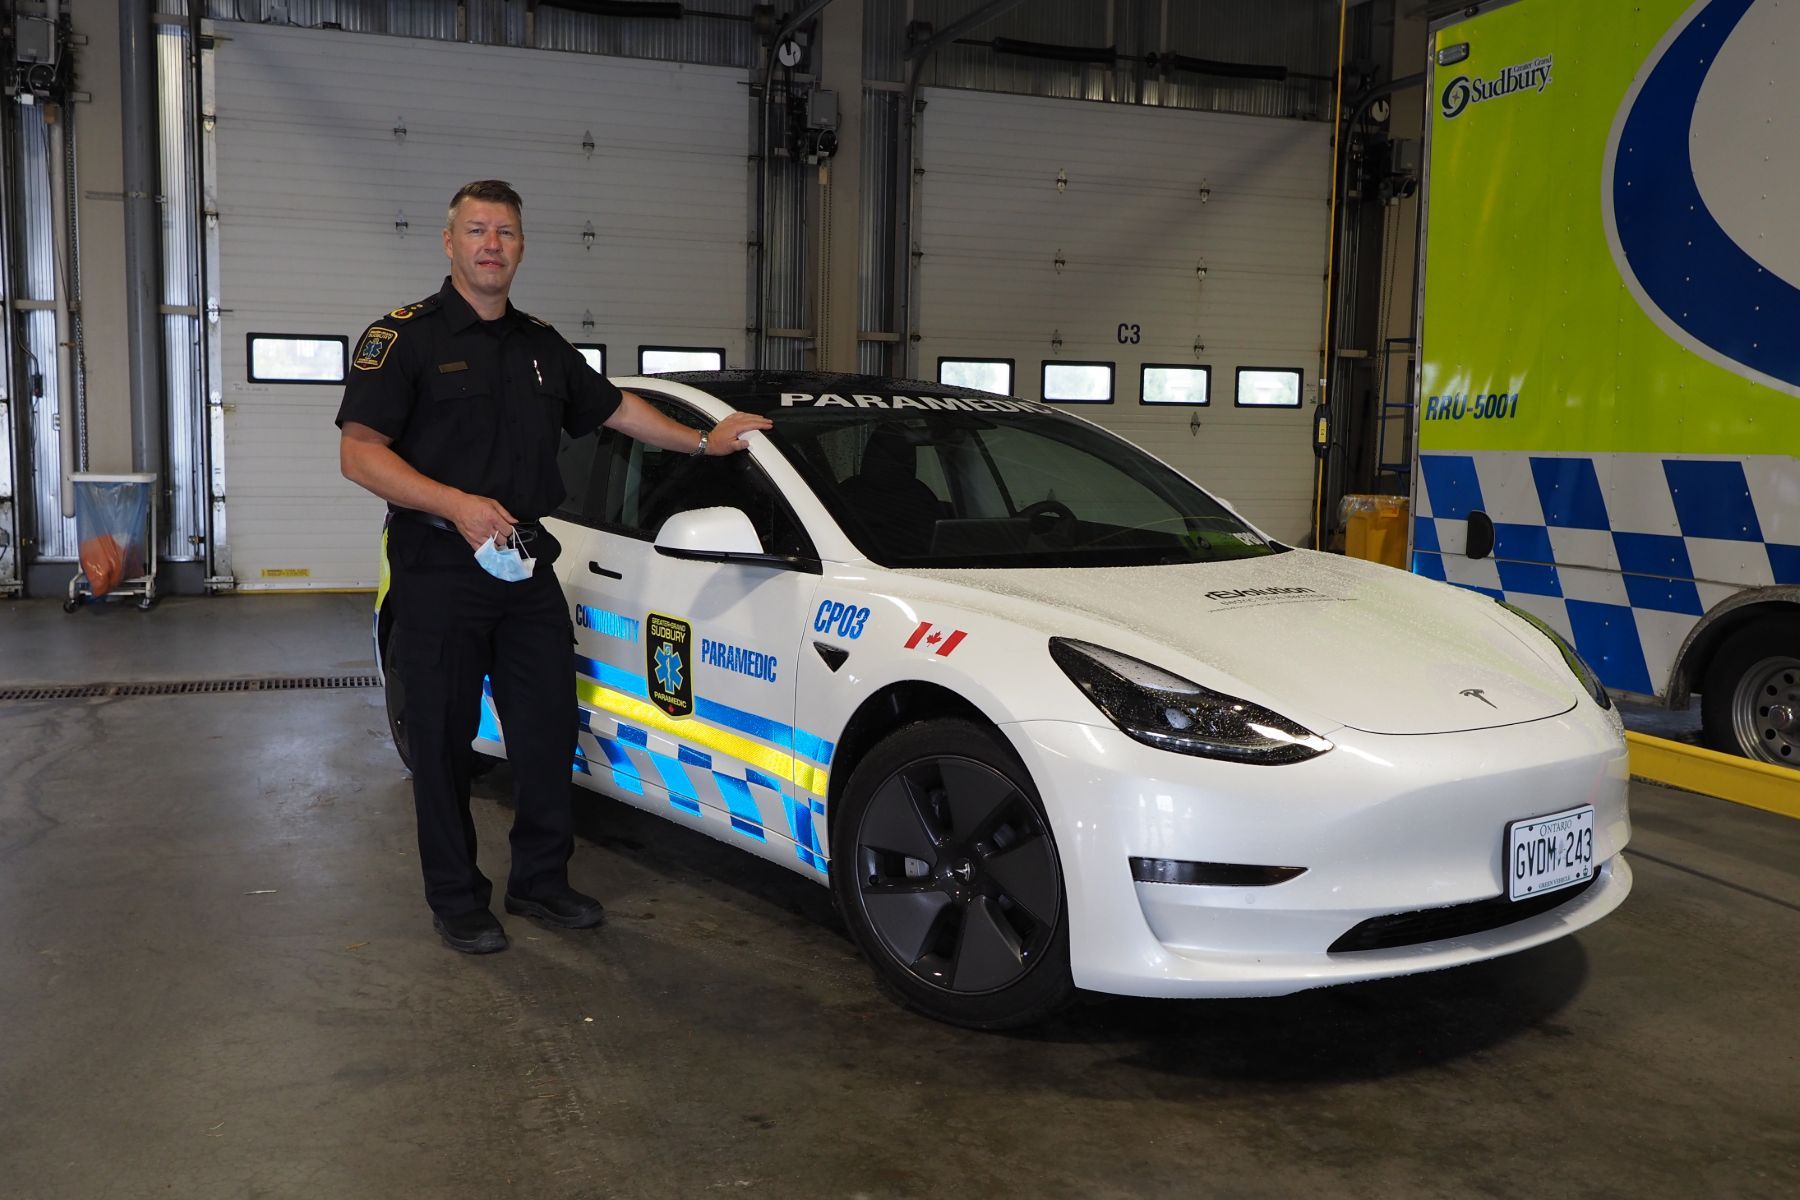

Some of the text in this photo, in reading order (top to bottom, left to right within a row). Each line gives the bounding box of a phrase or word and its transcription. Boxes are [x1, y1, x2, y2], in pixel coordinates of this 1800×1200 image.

[1471, 65, 1552, 103] Sudbury
[1117, 323, 1141, 344] C3
[780, 392, 1053, 414] PARAMEDIC
[1425, 393, 1519, 420] RRU-5001
[576, 603, 640, 644] COMMUNITY
[651, 624, 686, 643] SUDBURY
[814, 599, 871, 640] CP03
[701, 638, 778, 683] PARAMEDIC
[653, 691, 687, 709] PARAMEDIC
[1516, 827, 1592, 880] GVDM 243
